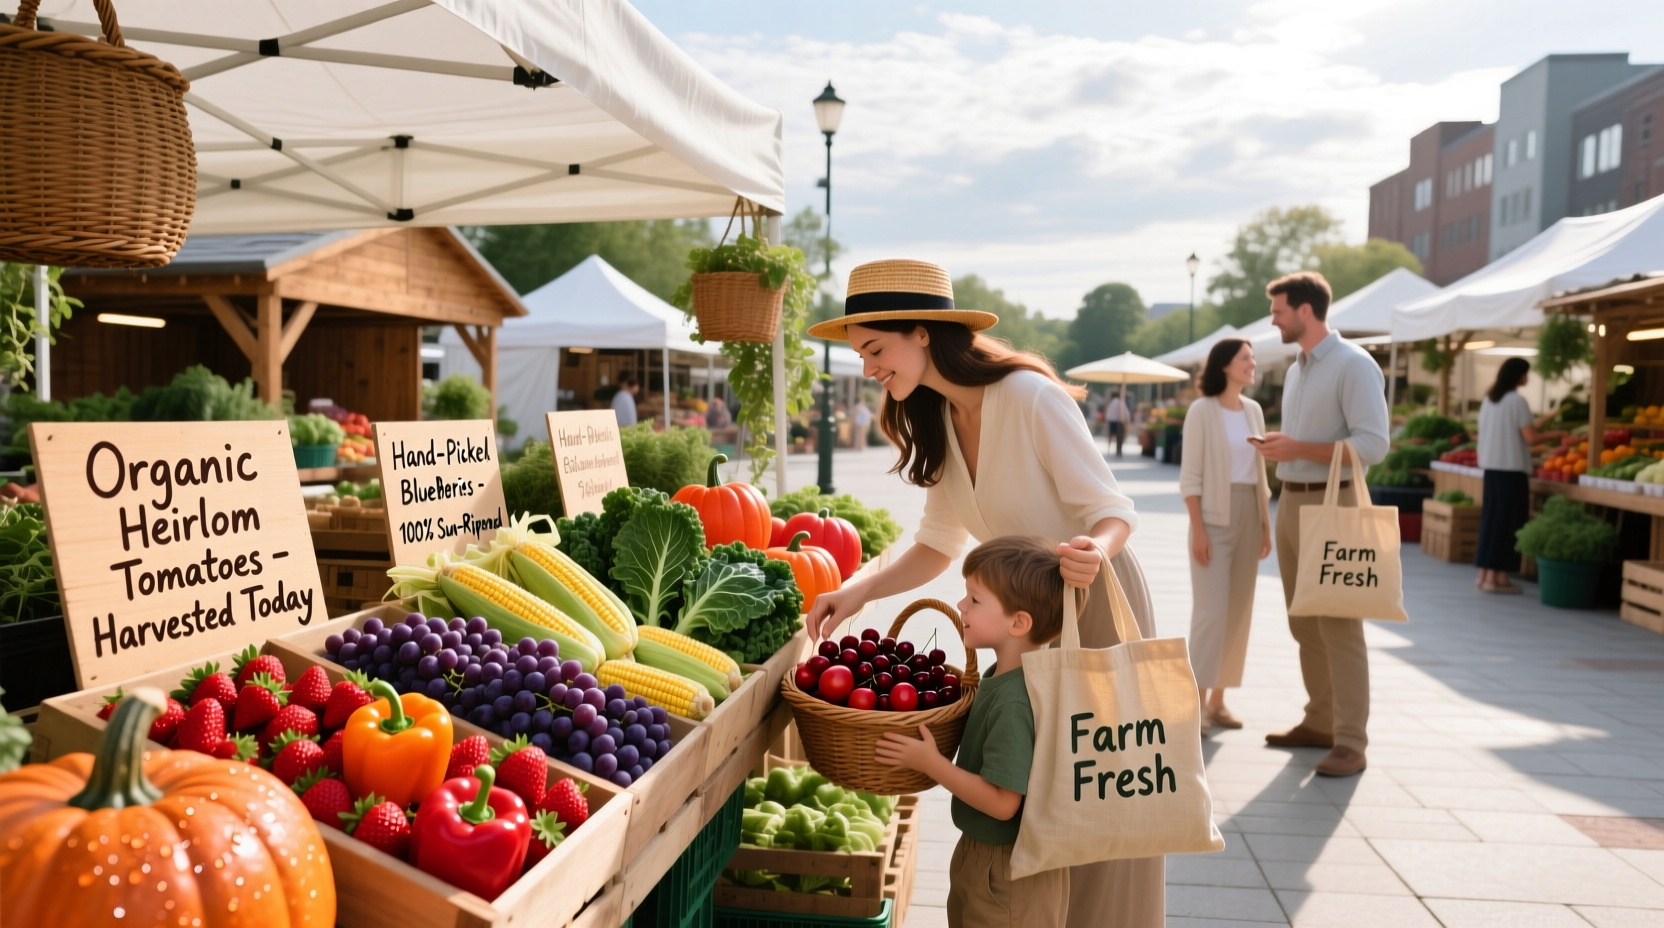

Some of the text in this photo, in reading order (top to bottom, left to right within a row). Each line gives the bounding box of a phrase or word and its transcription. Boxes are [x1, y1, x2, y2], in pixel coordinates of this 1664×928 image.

[86, 441, 258, 510] Organic
[119, 496, 260, 551] Heirlom
[399, 517, 434, 544] 100%
[109, 548, 263, 601] Tomatoes
[1319, 563, 1378, 588] Fresh
[1324, 541, 1376, 562] Farm
[92, 580, 313, 658] Harvested Today
[1070, 712, 1166, 754] Farm
[1073, 752, 1177, 802] Fresh
